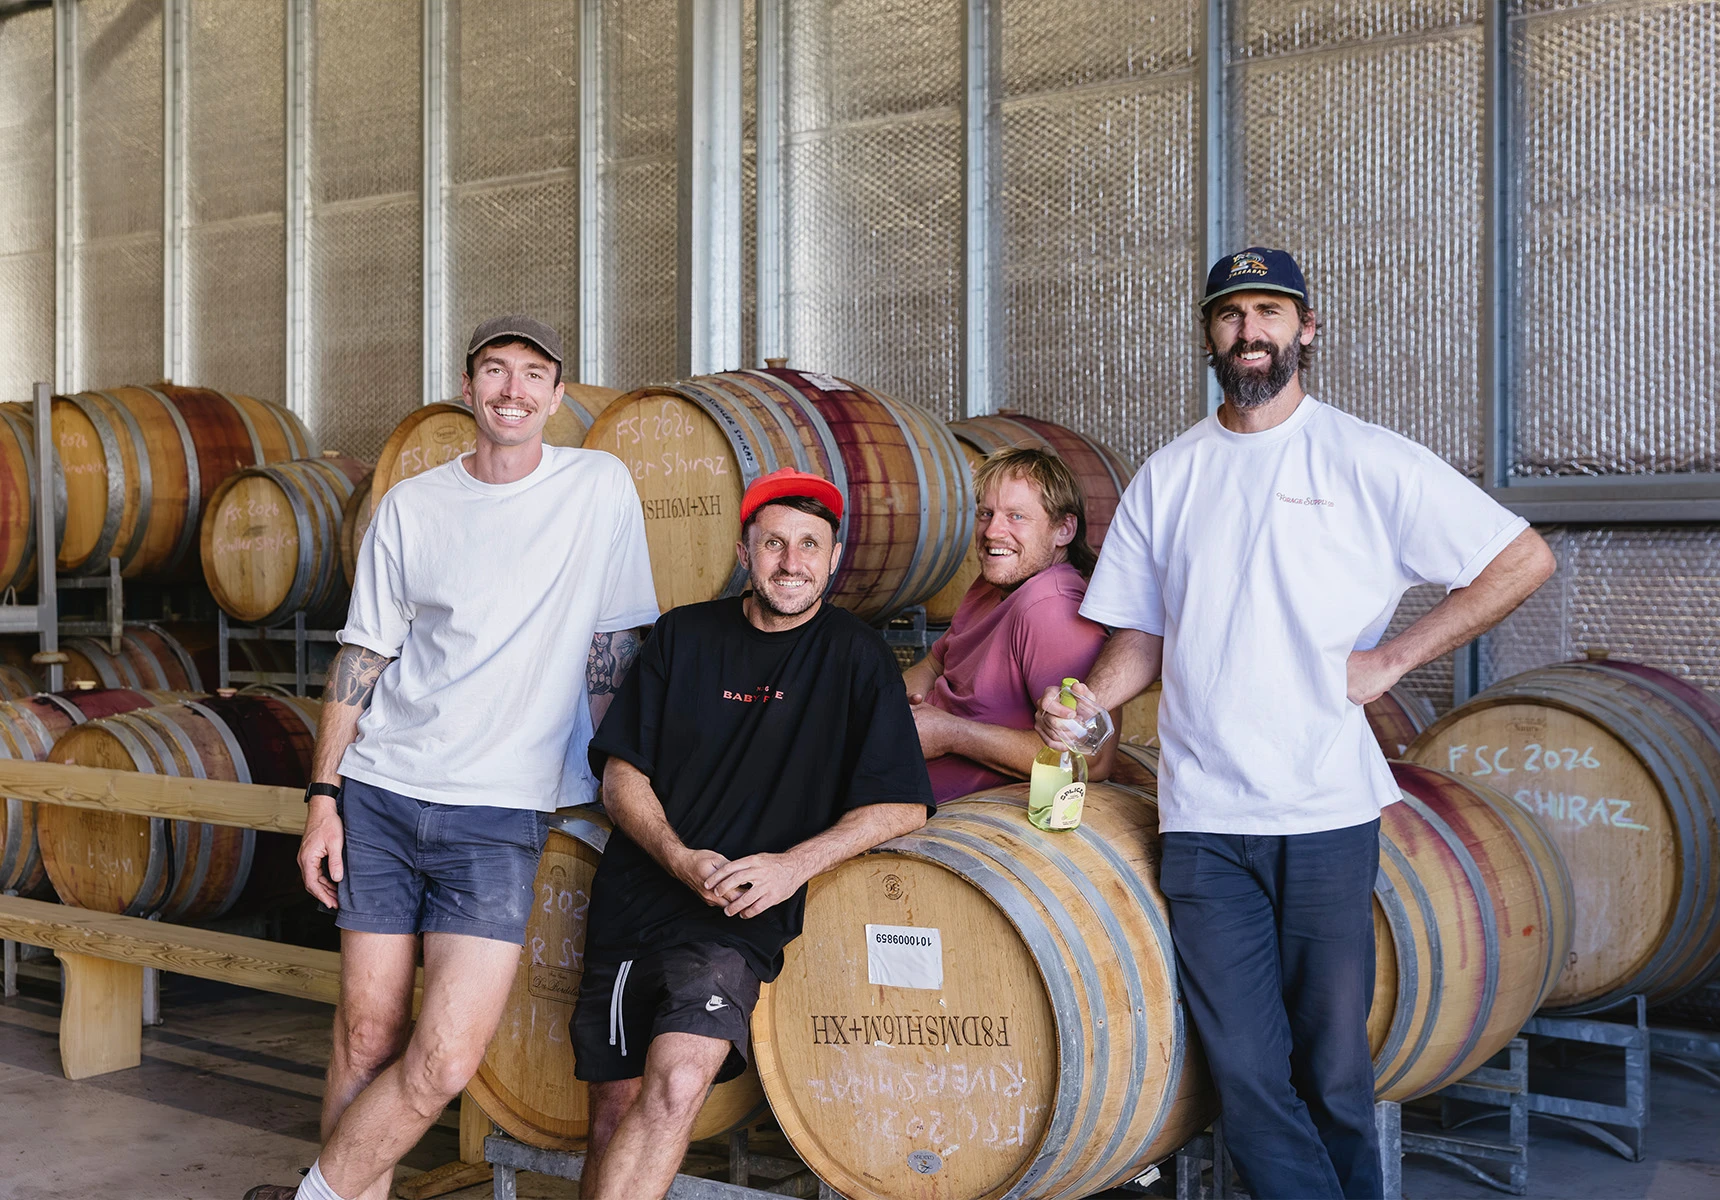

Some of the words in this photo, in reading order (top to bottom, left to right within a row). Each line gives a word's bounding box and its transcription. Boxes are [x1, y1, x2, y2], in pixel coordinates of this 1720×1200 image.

[653, 411, 695, 440] 2026
[1448, 744, 1515, 777] FSC
[1523, 743, 1601, 772] 2026
[542, 884, 590, 920] 202
[875, 932, 932, 947] 1010009859
[810, 1015, 1011, 1048] F8DMSHI6M+XH
